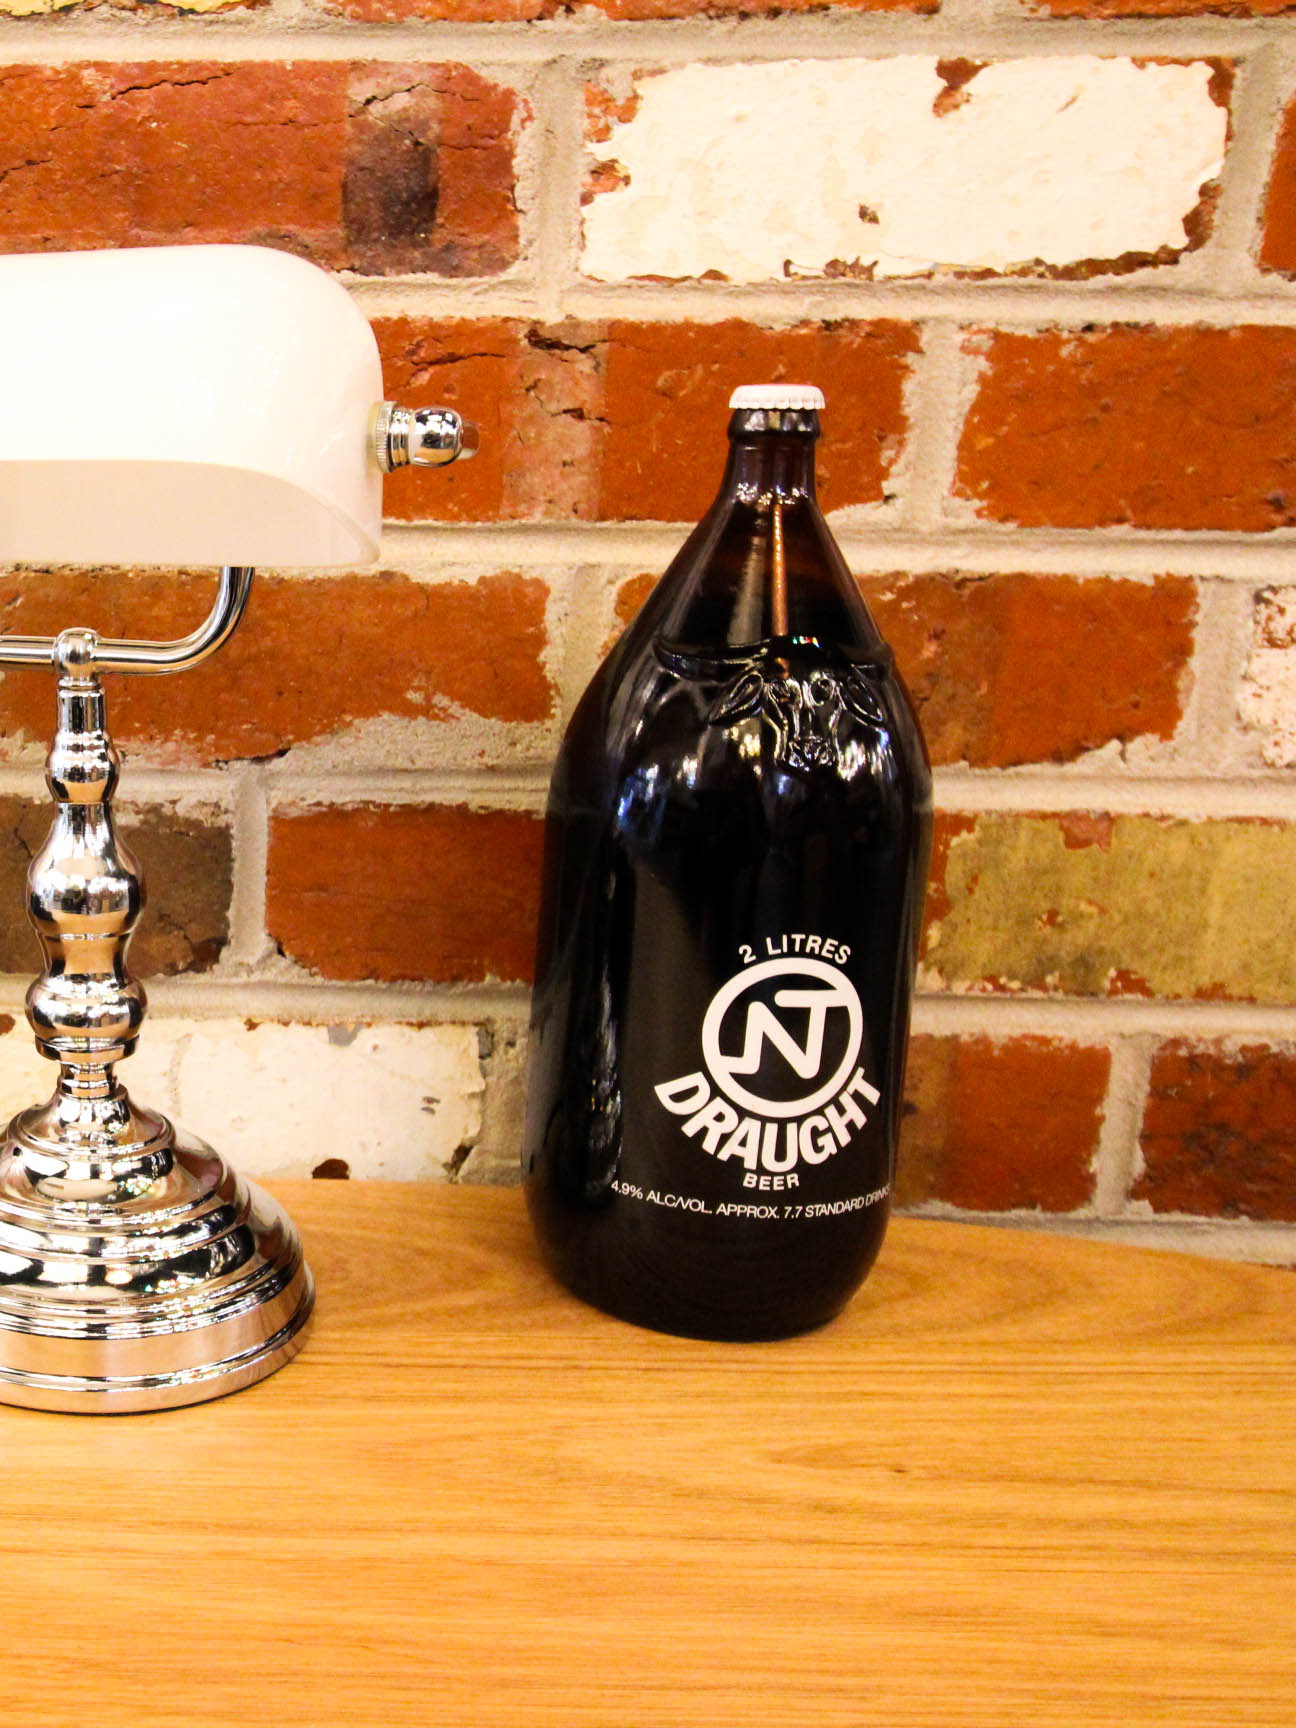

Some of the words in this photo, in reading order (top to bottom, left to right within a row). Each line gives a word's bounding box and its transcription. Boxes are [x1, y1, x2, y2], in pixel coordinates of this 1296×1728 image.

[738, 944, 757, 964] 2
[765, 933, 852, 965] LITRES
[654, 1066, 881, 1173] DRAUGHT
[611, 1179, 644, 1200] 4.9%
[715, 1202, 780, 1219] APPROX.
[784, 1205, 803, 1219] 7.7
[804, 1196, 865, 1218] STANDARD
[742, 1172, 800, 1191] BEER
